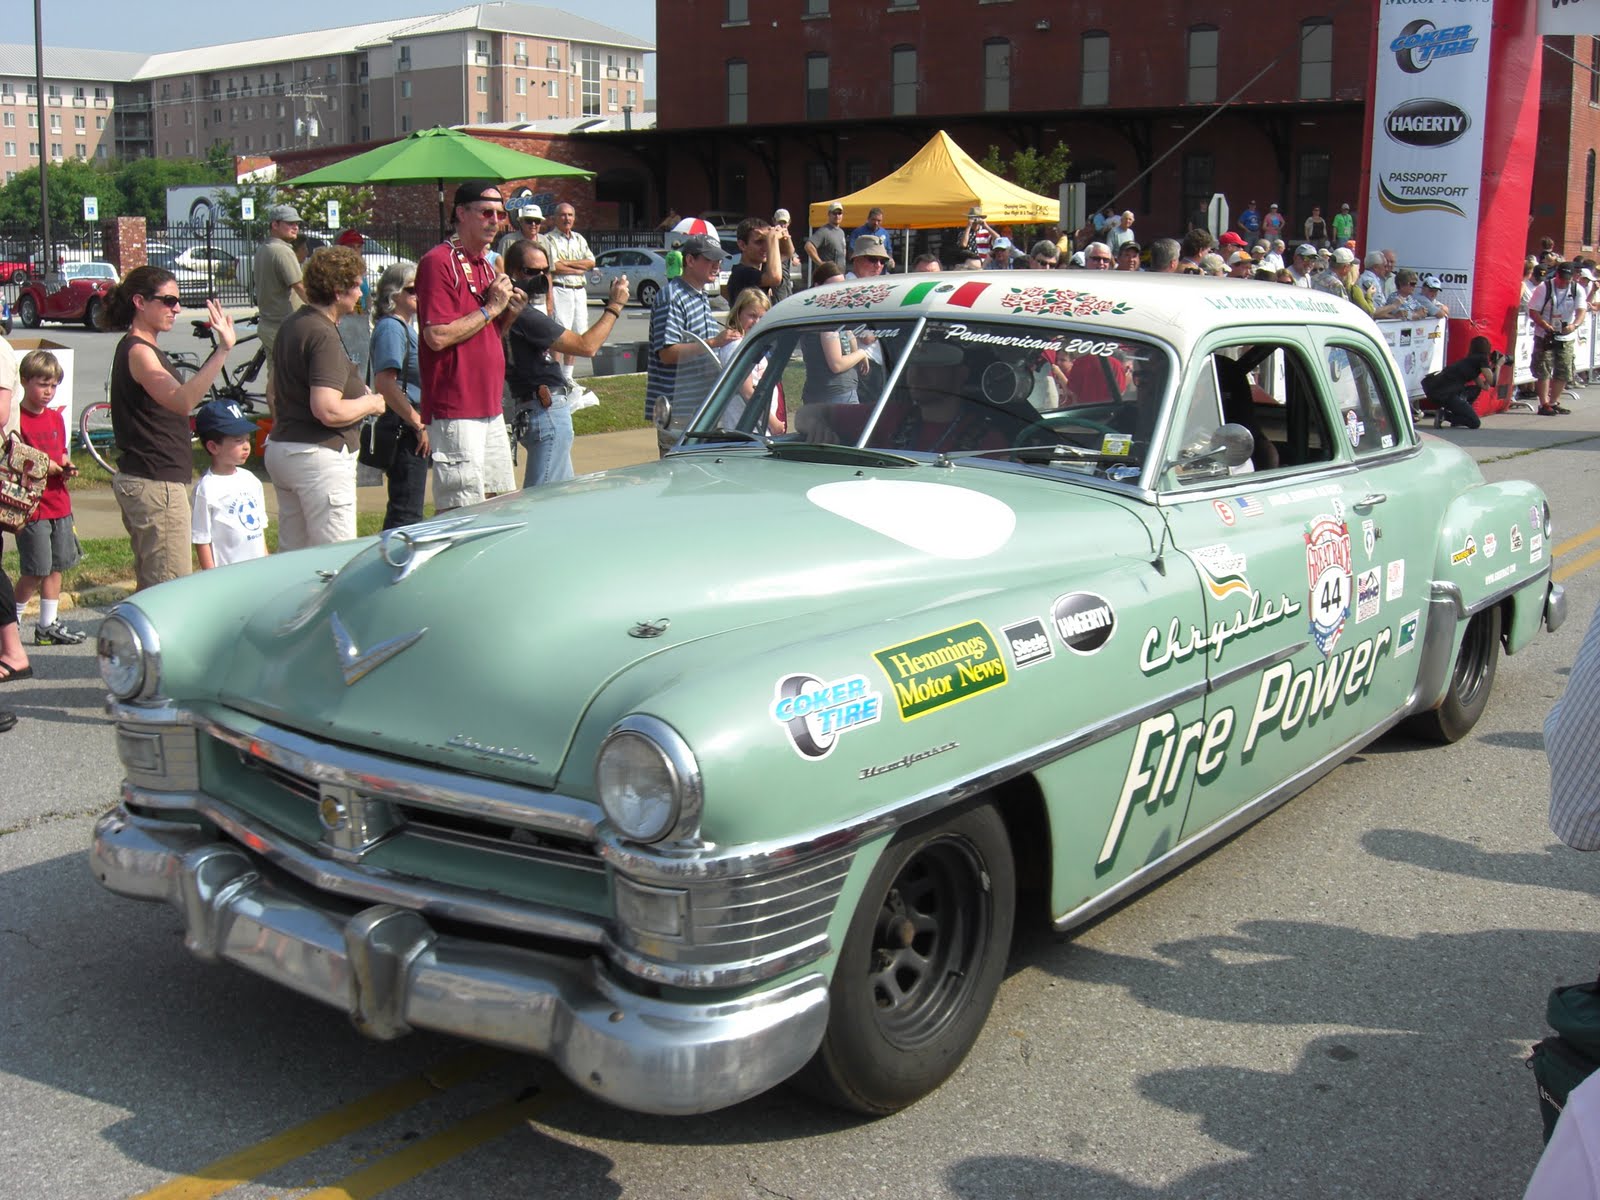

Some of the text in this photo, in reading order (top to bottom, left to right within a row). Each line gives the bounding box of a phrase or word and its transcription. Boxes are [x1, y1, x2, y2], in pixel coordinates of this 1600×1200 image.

[1390, 25, 1472, 52] COKER
[1418, 38, 1478, 61] TIRE
[1391, 116, 1462, 132] HAGERTY
[1389, 172, 1447, 182] PASSPORT
[1400, 186, 1468, 197] TRANSPORT
[945, 324, 1061, 351] Panamericana
[1065, 339, 1118, 357] 2003
[1321, 577, 1342, 613] 44
[1057, 606, 1112, 638] HAGERTY
[1139, 589, 1301, 674] Chrysler
[889, 637, 988, 678] Hemmings
[1012, 633, 1048, 657] Steele
[895, 658, 1003, 708] Motor News
[776, 679, 866, 721] COKER
[818, 697, 878, 736] TIRE
[1096, 626, 1392, 866] Fire Power
